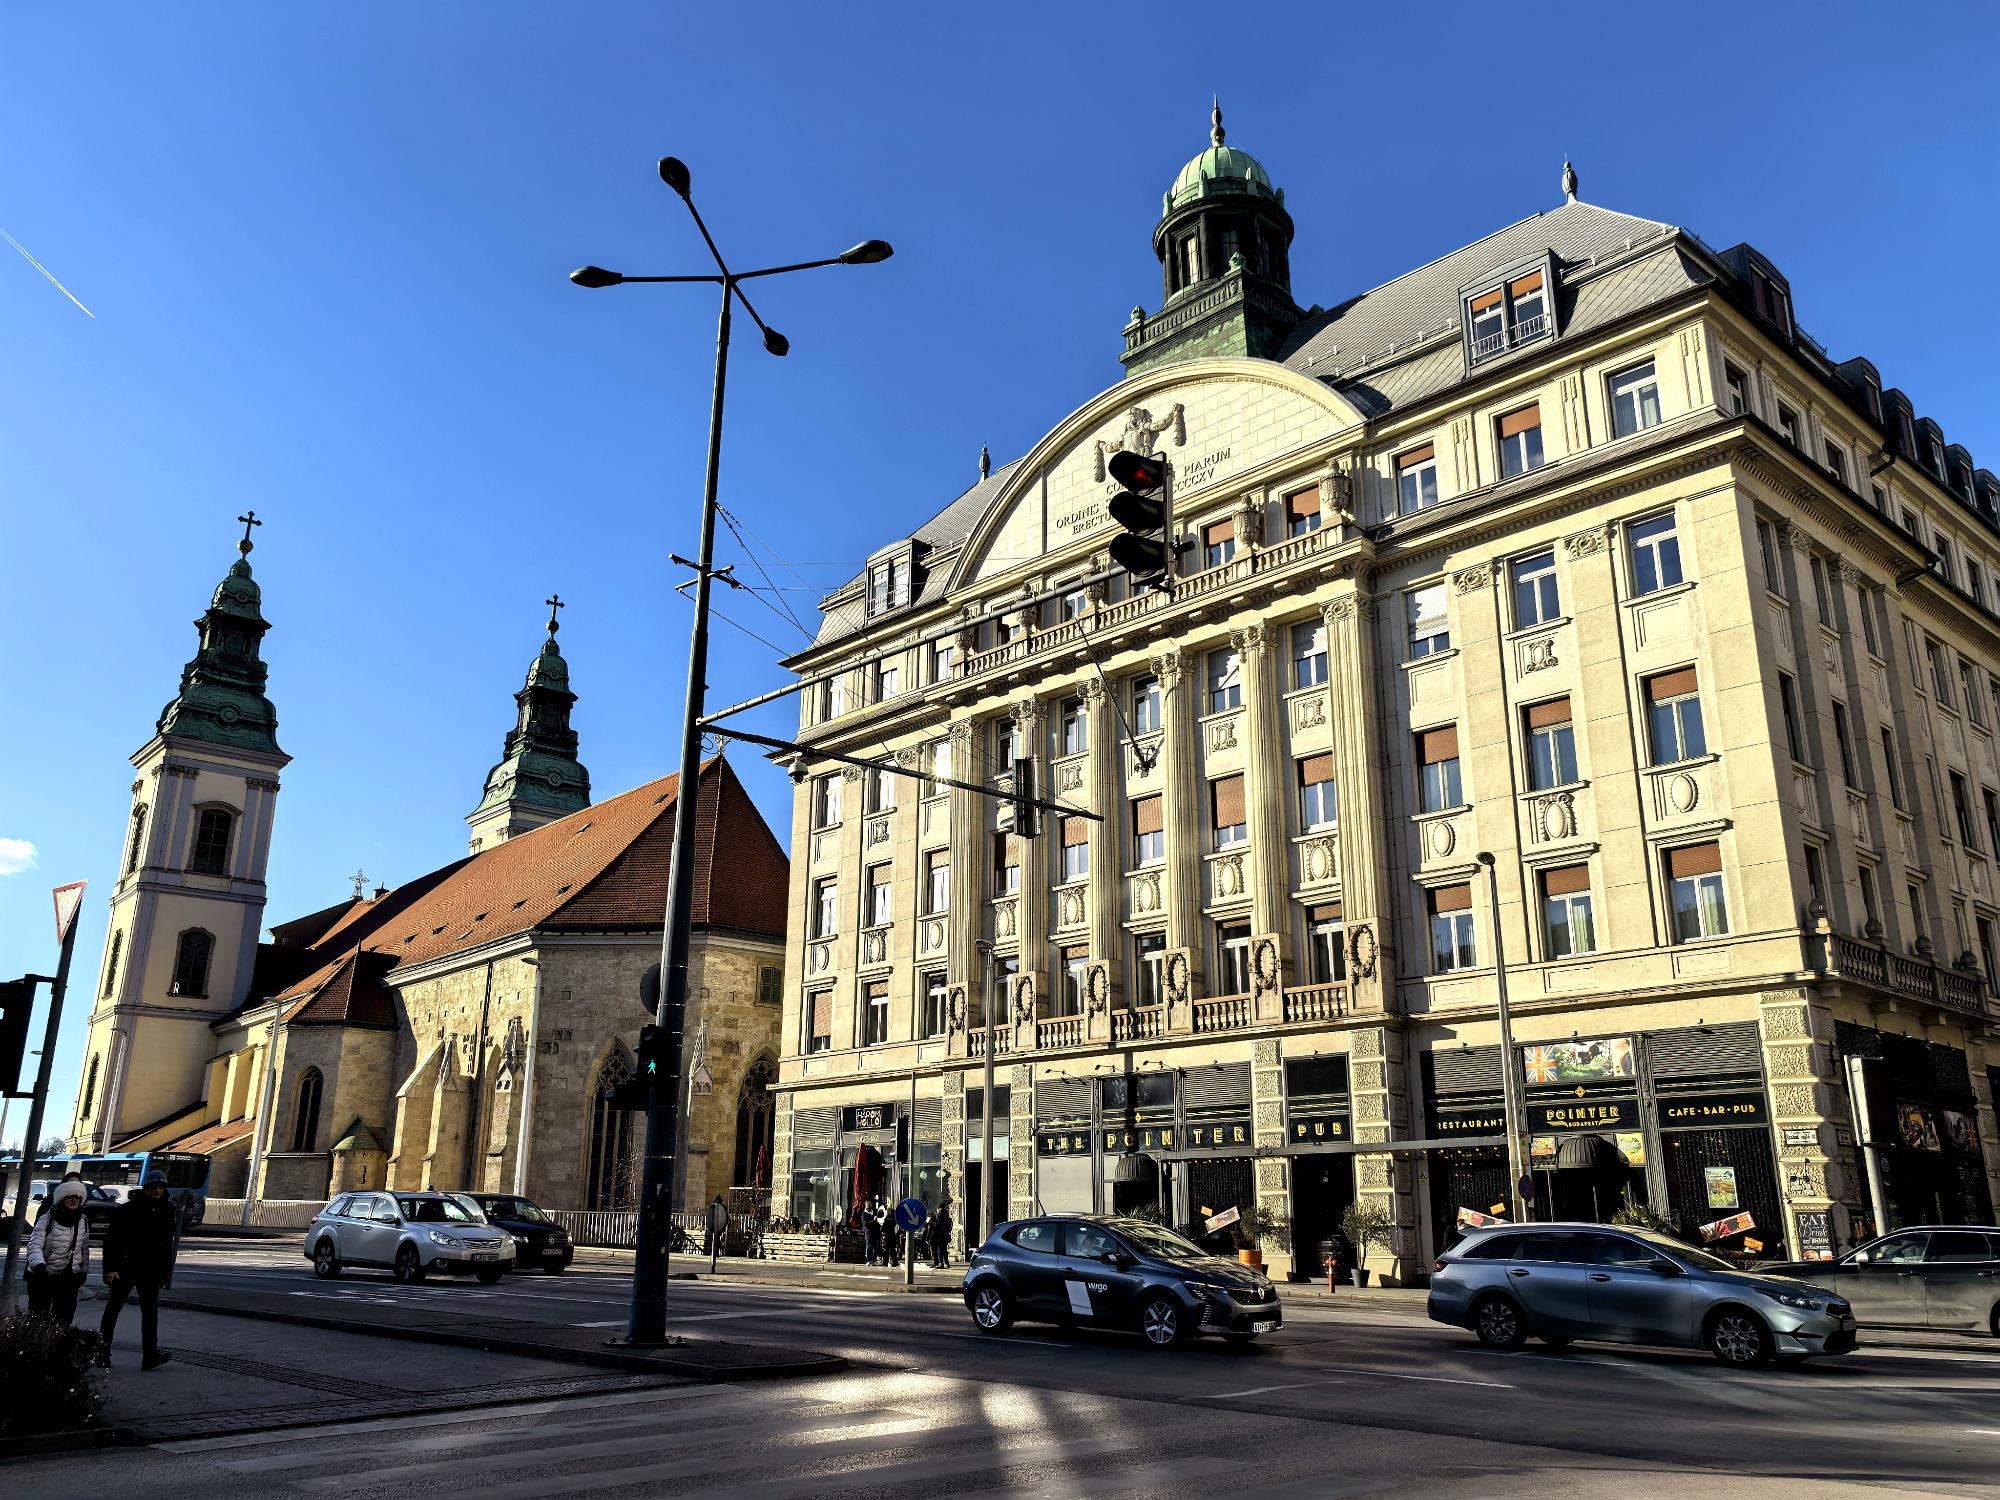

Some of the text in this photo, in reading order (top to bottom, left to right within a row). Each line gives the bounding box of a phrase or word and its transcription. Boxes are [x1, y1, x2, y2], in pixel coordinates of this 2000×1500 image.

[1056, 503, 1100, 529] ORDINIS
[1183, 447, 1231, 477] PIARUM
[1071, 512, 1113, 536] ERECTU
[1546, 1105, 1620, 1120] POINTER
[1668, 1104, 1756, 1117] CAFE BAR PUB
[1437, 1119, 1504, 1130] RESTAURANT
[1568, 1120, 1599, 1128] BUDAPEST
[1047, 1137, 1082, 1150] THE
[1297, 1122, 1342, 1137] PUB
[1798, 1214, 1827, 1226] EAT
[1798, 1224, 1829, 1238] Drink
